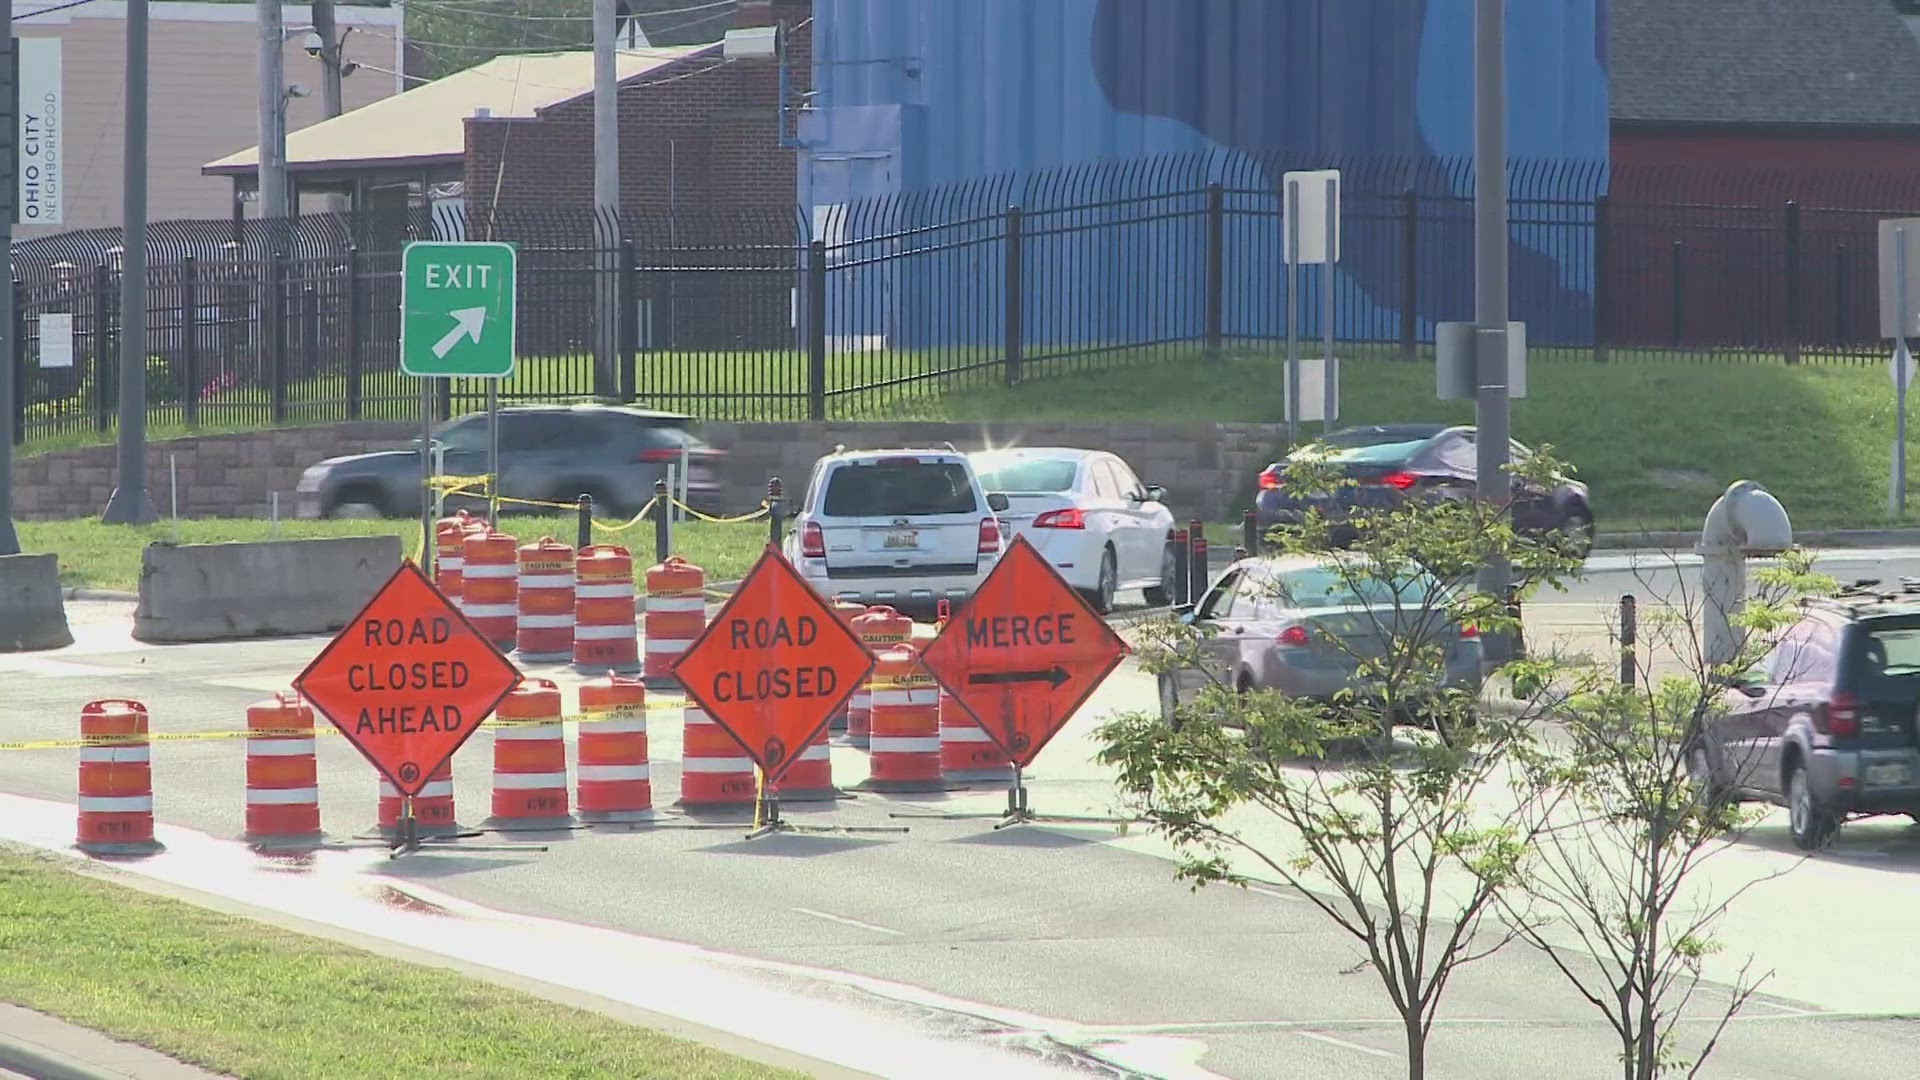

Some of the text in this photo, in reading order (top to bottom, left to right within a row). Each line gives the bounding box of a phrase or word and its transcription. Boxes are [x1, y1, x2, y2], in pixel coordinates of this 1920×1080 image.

[25, 113, 40, 219] OHIO CITY
[45, 93, 56, 220] NEIGHBORHOOD
[425, 263, 492, 289] EXIT
[364, 617, 450, 647] ROAD
[730, 615, 818, 650] ROAD
[862, 634, 904, 643] CAUTION
[966, 613, 1076, 651] MERGE
[348, 661, 469, 692] CLOSED
[713, 665, 837, 703] CLOSED
[355, 705, 462, 735] AHEAD
